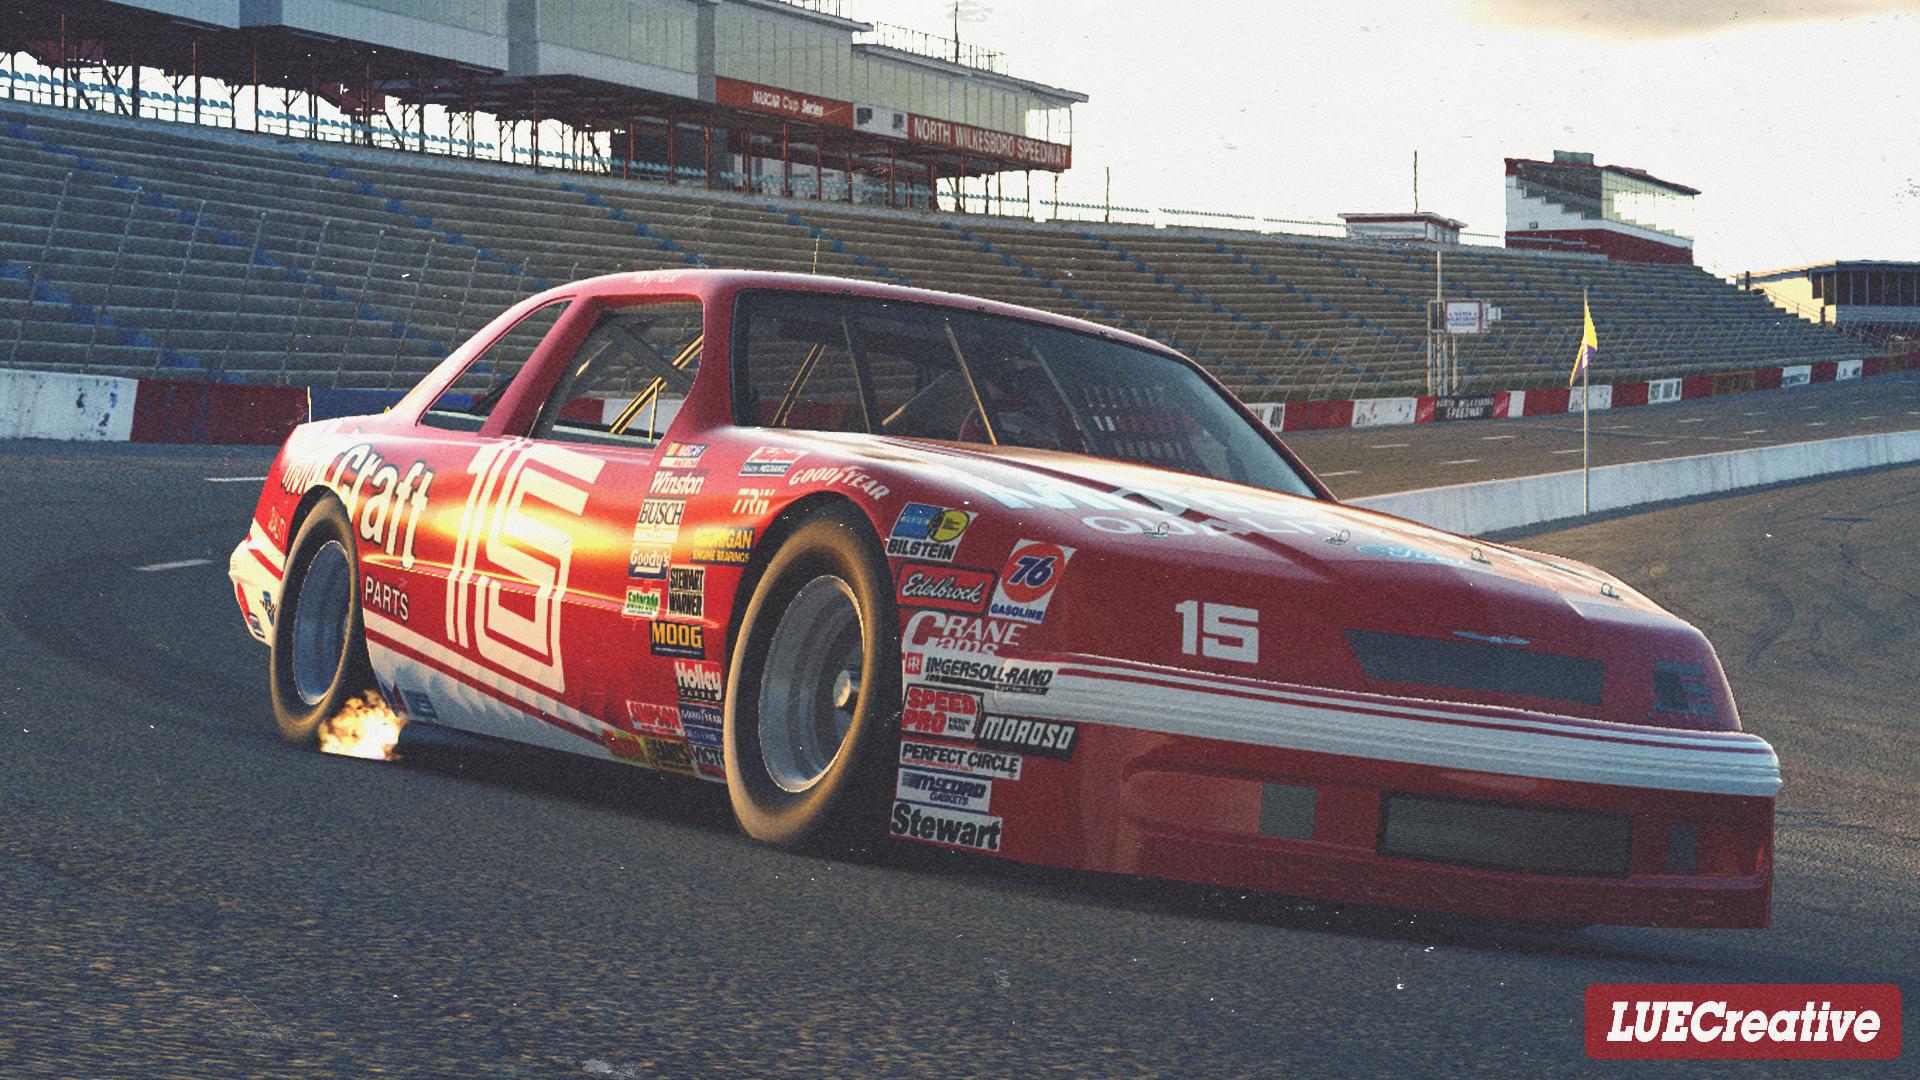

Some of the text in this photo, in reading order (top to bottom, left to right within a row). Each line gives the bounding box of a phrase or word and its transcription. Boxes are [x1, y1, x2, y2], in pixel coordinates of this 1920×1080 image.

[783, 96, 799, 113] Cup
[914, 117, 1067, 166] NORTH WILKESBORO SPEEDWAY
[649, 471, 705, 495] Winston
[788, 465, 890, 500] GOODYEAR
[638, 501, 685, 525] BUSCH
[630, 549, 669, 568] Goody's
[887, 538, 956, 560] BILSTEIN
[446, 436, 606, 694] 15
[670, 567, 704, 591] STEWART
[1008, 556, 1058, 588] 76
[365, 576, 409, 621] PARTS
[902, 573, 985, 604] Edelbrock
[668, 592, 703, 617] WARNER
[991, 604, 1044, 621] GASOLINE
[651, 622, 703, 648] MOOG
[1175, 600, 1259, 664] 15
[675, 661, 721, 700] Holley
[908, 688, 977, 715] SPEED
[901, 709, 947, 734] PRO
[979, 716, 1075, 750] MOROSO
[902, 743, 967, 765] PERFECT
[967, 751, 1020, 774] CIRCLE
[891, 803, 1000, 850] Stewart
